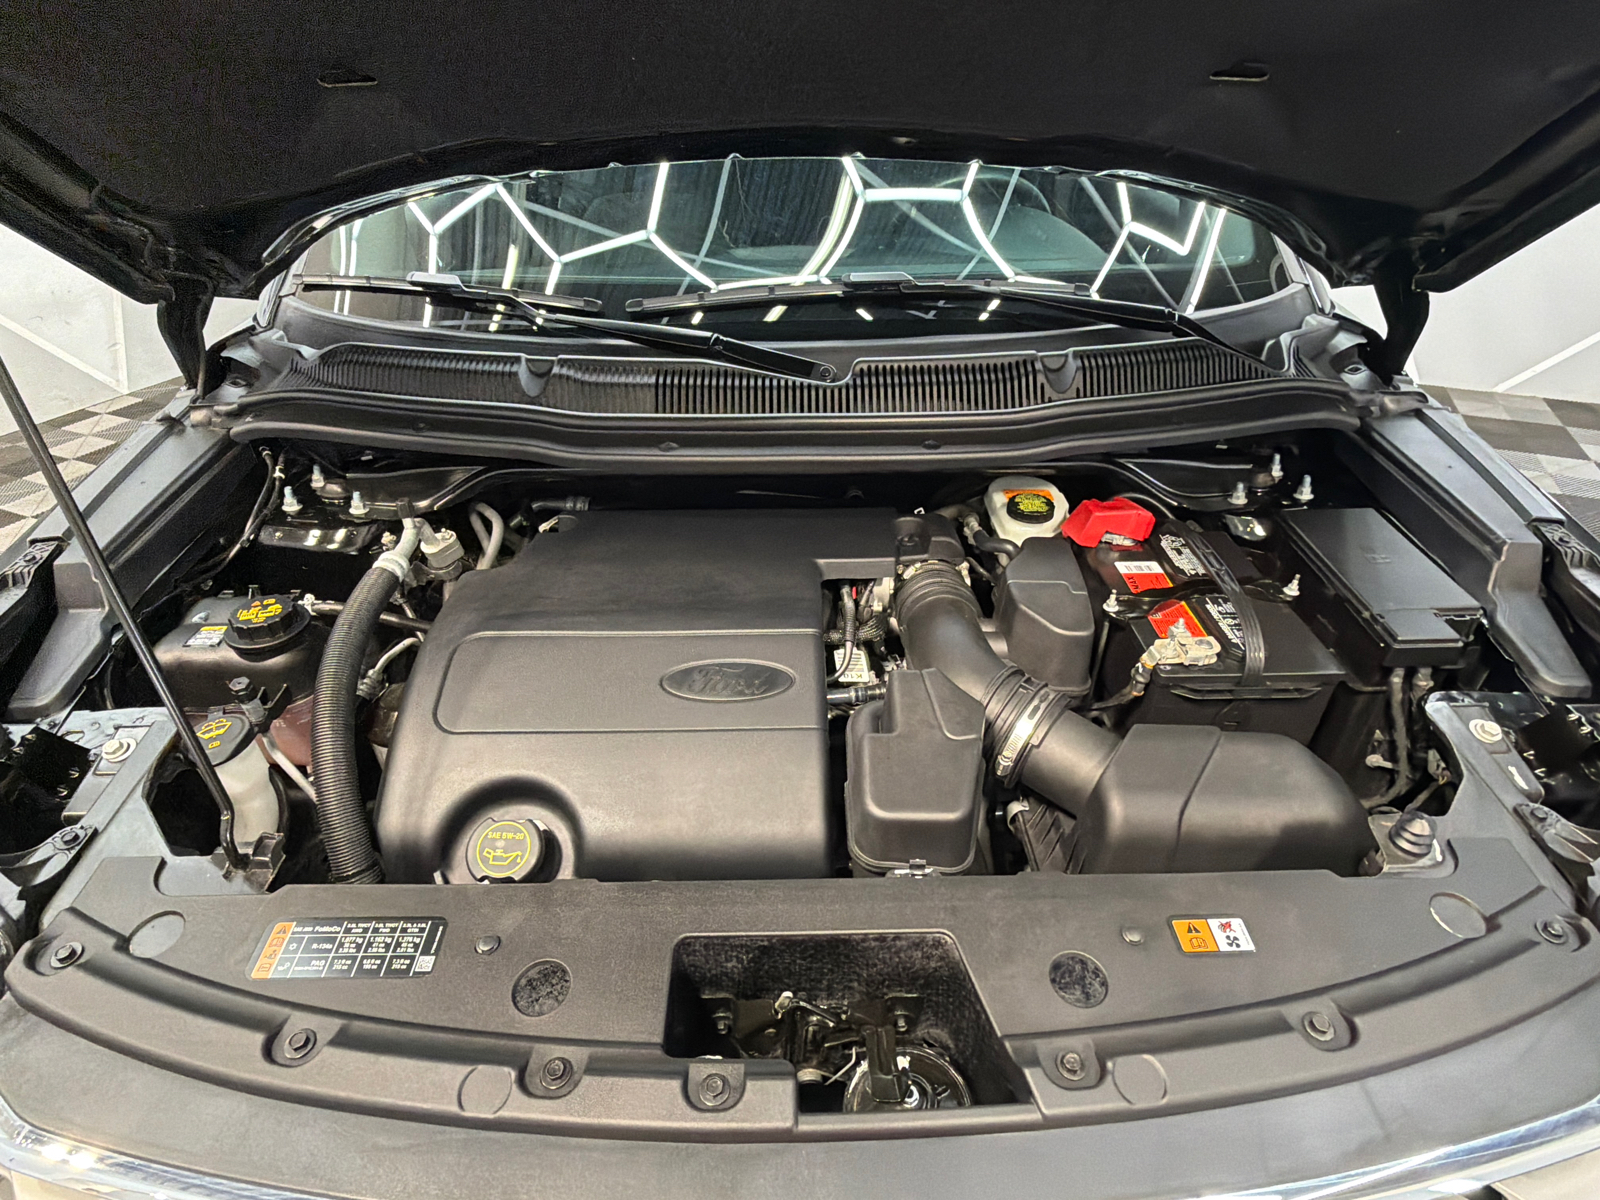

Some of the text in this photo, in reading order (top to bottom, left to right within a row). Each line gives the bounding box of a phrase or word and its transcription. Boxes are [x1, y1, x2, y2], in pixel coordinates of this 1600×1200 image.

[687, 664, 771, 695] Ford
[487, 831, 525, 840] SAE 5W-20
